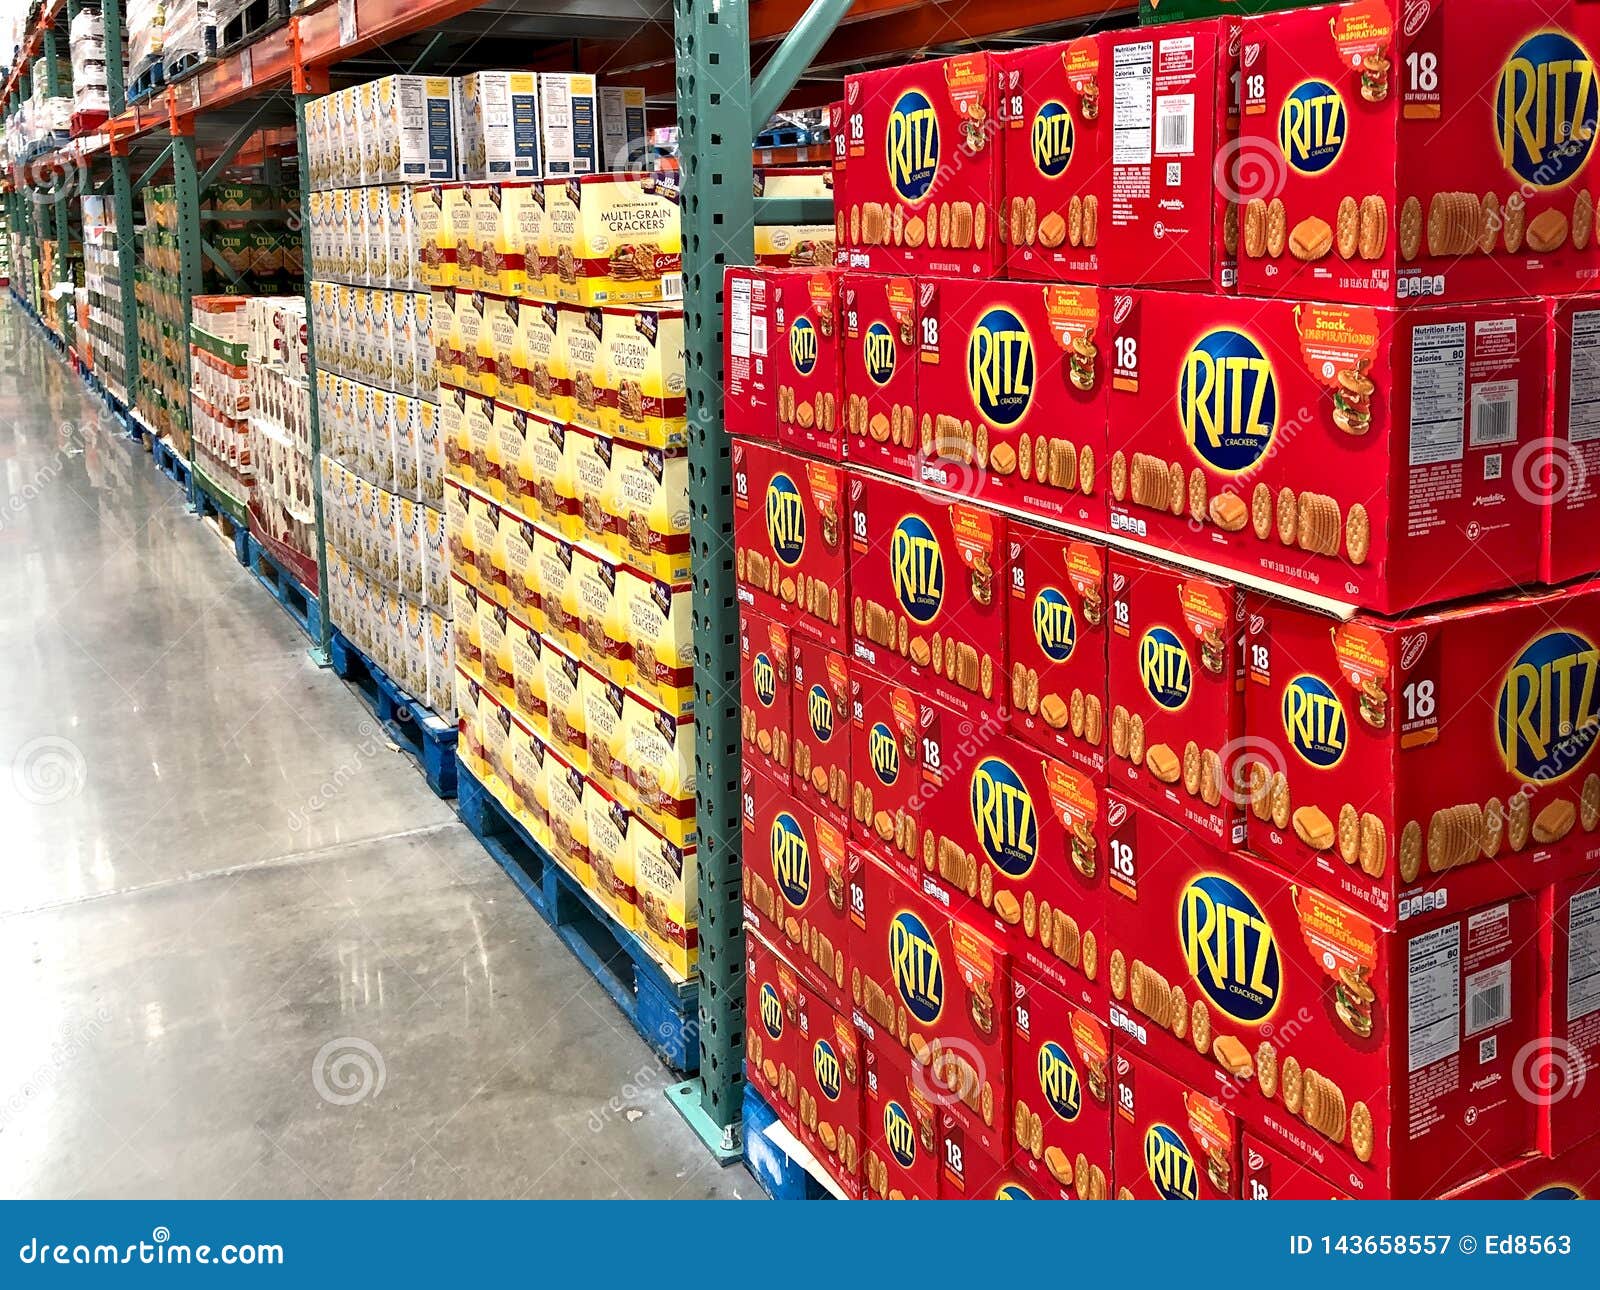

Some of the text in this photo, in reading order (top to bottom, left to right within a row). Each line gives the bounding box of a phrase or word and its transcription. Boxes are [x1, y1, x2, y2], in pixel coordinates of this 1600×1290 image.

[1346, 20, 1368, 32] Snack
[1406, 4, 1427, 33] NABISCO
[1142, 66, 1152, 75] 80
[1406, 52, 1438, 91] 18
[1246, 75, 1265, 98] 18
[1011, 96, 1023, 115] 18
[1502, 58, 1593, 168] RITZ
[850, 113, 863, 139] 18
[1034, 112, 1073, 165] RITZ
[1284, 95, 1342, 162] RITZ
[835, 134, 845, 156] 18
[890, 108, 935, 188] RITZ
[224, 189, 243, 198] CLUB
[601, 209, 671, 221] MULTI-GRAIN
[609, 220, 664, 231] CRACKERS
[776, 307, 784, 323] 18
[848, 311, 858, 328] 18
[1316, 317, 1346, 330] Snack
[922, 318, 938, 344] 18
[1414, 327, 1445, 335] Nutrition
[611, 342, 648, 357] MULTI-GRAIN
[791, 326, 815, 368] RITZ
[866, 331, 894, 377] RITZ
[1115, 336, 1137, 369] 18
[1413, 350, 1464, 363] Calories 80
[614, 354, 645, 369] CRACKERS
[973, 327, 1030, 407] RITZ
[1187, 350, 1271, 447] RITZ
[1225, 438, 1258, 446] CRACKERS
[624, 485, 651, 505] CRACKERS
[736, 473, 747, 495] 18
[767, 486, 803, 546] RITZ
[853, 511, 867, 537] 18
[893, 529, 941, 603] RITZ
[1012, 566, 1025, 587] 18
[1035, 597, 1072, 647] RITZ
[1114, 600, 1129, 623] 18
[1143, 635, 1188, 693] RITZ
[1252, 644, 1268, 670] 18
[1403, 635, 1426, 668] NABISCO
[755, 659, 774, 699] RITZ
[795, 665, 803, 681] 18
[810, 690, 832, 731] RITZ
[853, 701, 863, 718] 18
[1403, 679, 1435, 720] 18
[1506, 650, 1599, 772] RITZ
[1288, 684, 1342, 748] RITZ
[871, 728, 897, 773] RITZ
[923, 737, 940, 768] 18
[744, 793, 754, 817] 18
[974, 770, 1033, 854] RITZ
[773, 821, 808, 894] RITZ
[1110, 840, 1135, 877] 18
[851, 883, 865, 912] 18
[1313, 906, 1344, 929] Snack
[1187, 886, 1273, 998] RITZ
[1410, 925, 1458, 946] Nutrition Facts
[892, 919, 940, 1004] RITZ
[1410, 949, 1458, 973] Calories 80
[1229, 984, 1264, 1005] CRACKERS
[761, 990, 781, 1036] RITZ
[799, 1013, 808, 1031] 18
[1017, 1006, 1030, 1029] 18
[815, 1046, 840, 1098] RITZ
[868, 1070, 877, 1090] 18
[1041, 1048, 1078, 1116] RITZ
[1118, 1083, 1134, 1108] 18
[885, 1107, 914, 1166] RITZ
[945, 1139, 962, 1172] 18
[1149, 1129, 1195, 1197] RITZ
[1250, 1180, 1269, 1200] 18
